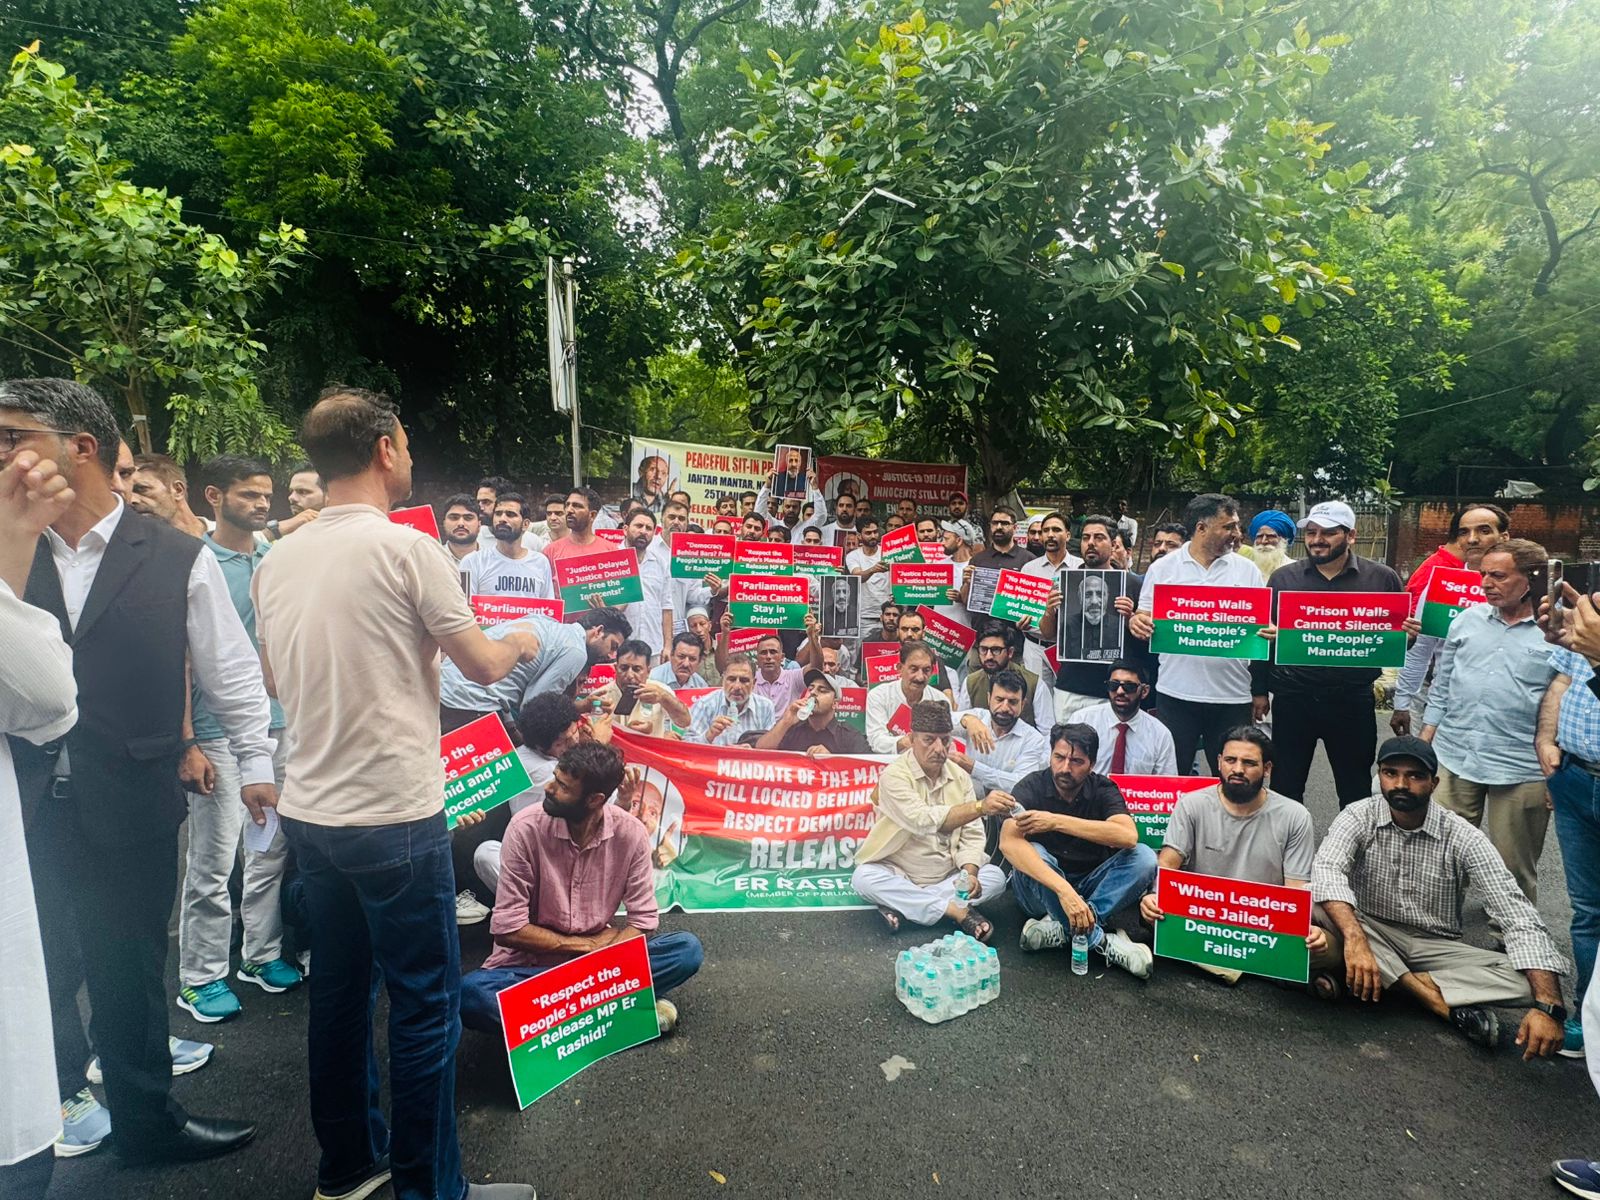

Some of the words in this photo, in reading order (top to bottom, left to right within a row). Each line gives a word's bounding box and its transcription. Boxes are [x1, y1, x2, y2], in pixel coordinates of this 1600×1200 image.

[686, 451, 730, 472] PEACEFUL
[733, 457, 759, 474] SIT-IN
[762, 460, 773, 475] PR
[688, 473, 717, 484] JANTAR
[720, 477, 755, 489] MANTAR,
[873, 486, 917, 500] INNOCENTS
[919, 488, 939, 500] STILL
[690, 504, 718, 515] ELEAS
[686, 542, 723, 550] “Democracy
[565, 564, 597, 574] “Justice
[598, 558, 629, 570] Delayed
[576, 573, 603, 584] Justice
[604, 568, 631, 578] Denied
[1019, 577, 1037, 587] More
[495, 576, 536, 593] JORDAN
[607, 579, 621, 587] the
[738, 581, 801, 591] “Parliament’s
[1441, 580, 1468, 593] “Set
[1015, 586, 1032, 594] More
[736, 593, 768, 601] Choice
[770, 594, 803, 603] Cannot
[1172, 597, 1215, 608] “Prison
[1218, 600, 1253, 610] Walls
[753, 604, 774, 614] Stay
[776, 605, 785, 613] in
[1006, 601, 1020, 609] and
[1300, 605, 1348, 616] “Prison
[1352, 607, 1390, 617] Walls
[750, 616, 788, 624] Prison!”
[1166, 610, 1209, 620] Cannot
[1212, 612, 1256, 623] Silence
[1174, 624, 1193, 633] the
[1196, 625, 1247, 637] People’s
[1294, 620, 1341, 630] Cannot
[1345, 620, 1392, 631] Silence
[1178, 636, 1240, 648] Mandate!”
[1302, 633, 1324, 642] the
[1328, 634, 1384, 645] People’s
[1308, 647, 1376, 657] Mandate!”
[451, 743, 475, 760] the
[471, 747, 502, 768] Free
[467, 767, 493, 788] and
[495, 757, 513, 773] All
[717, 759, 793, 784] MANDATE
[797, 767, 815, 787] OF
[820, 771, 849, 788] THE
[854, 764, 886, 785] MA
[704, 780, 747, 803] STILL
[751, 786, 813, 809] LOCKED
[1121, 788, 1173, 799] “Freedom
[1153, 802, 1164, 811] of
[723, 809, 794, 833] RESPECT
[798, 808, 876, 832] DEMOCRA
[749, 834, 866, 870] RELEAS
[734, 876, 767, 892] ER
[746, 891, 793, 899] (MEMBER
[1170, 881, 1225, 902] “When
[1230, 891, 1297, 913] Leaders
[1188, 904, 1216, 918] are
[1219, 908, 1275, 930] Jailed,
[1185, 919, 1278, 948] Democracy
[1204, 940, 1256, 959] Fails!”
[532, 974, 595, 1009] “Respect
[598, 966, 621, 983] the
[519, 1001, 577, 1040] People’s
[580, 978, 640, 1009] Mandate
[541, 1014, 594, 1049] Release
[597, 1003, 618, 1019] MP
[622, 996, 637, 1010] Er
[557, 1021, 613, 1060] Rashid!”
